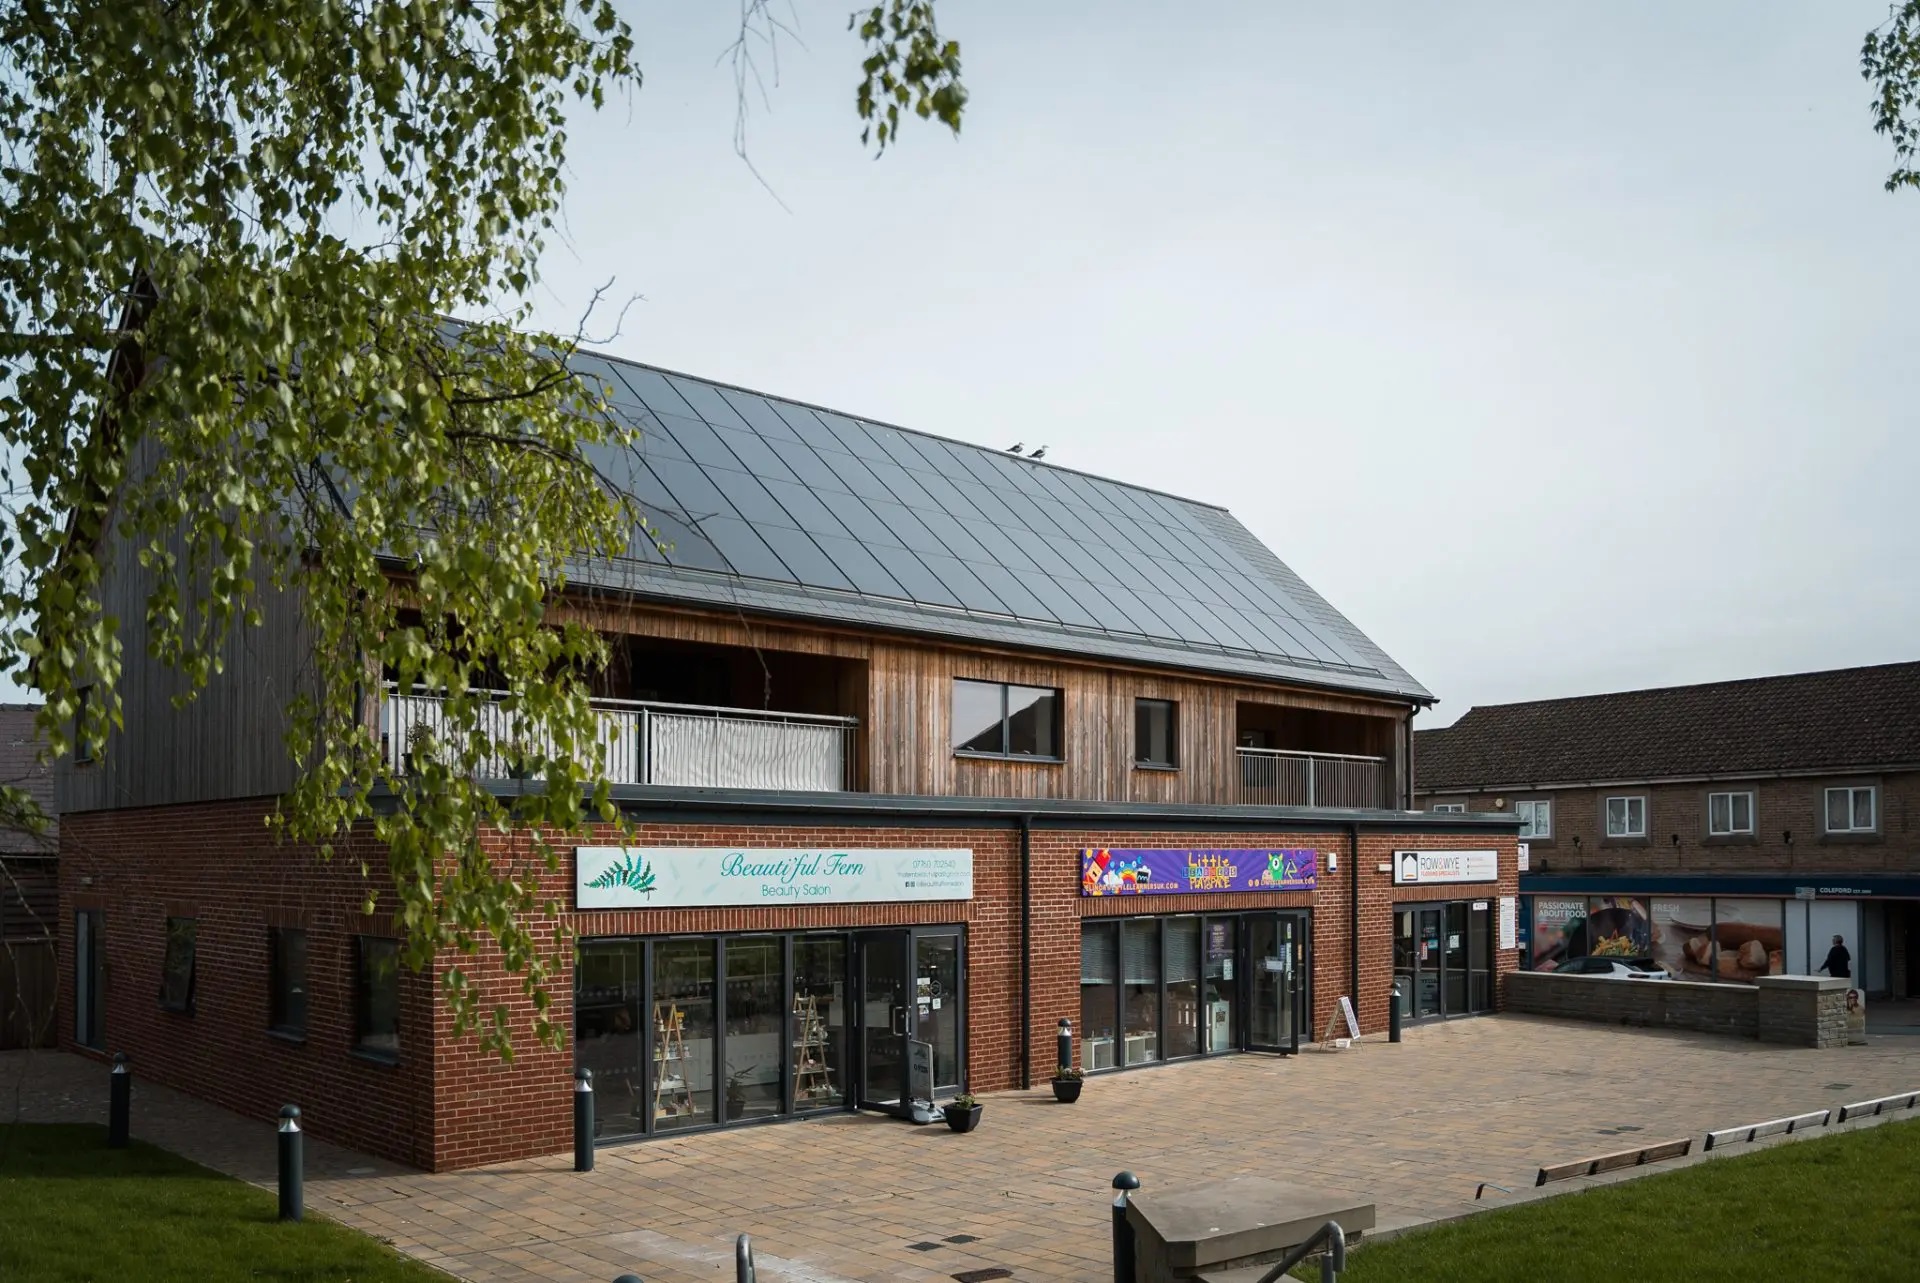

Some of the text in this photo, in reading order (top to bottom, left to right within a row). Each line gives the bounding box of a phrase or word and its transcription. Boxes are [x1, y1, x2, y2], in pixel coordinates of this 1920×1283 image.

[823, 853, 865, 876] Fern
[1188, 852, 1229, 867] Little
[762, 884, 831, 899] Beauty Salon
[1538, 902, 1584, 910] PASSIONATE
[1652, 903, 1680, 912] FRESH
[1565, 910, 1587, 918] FOOD
